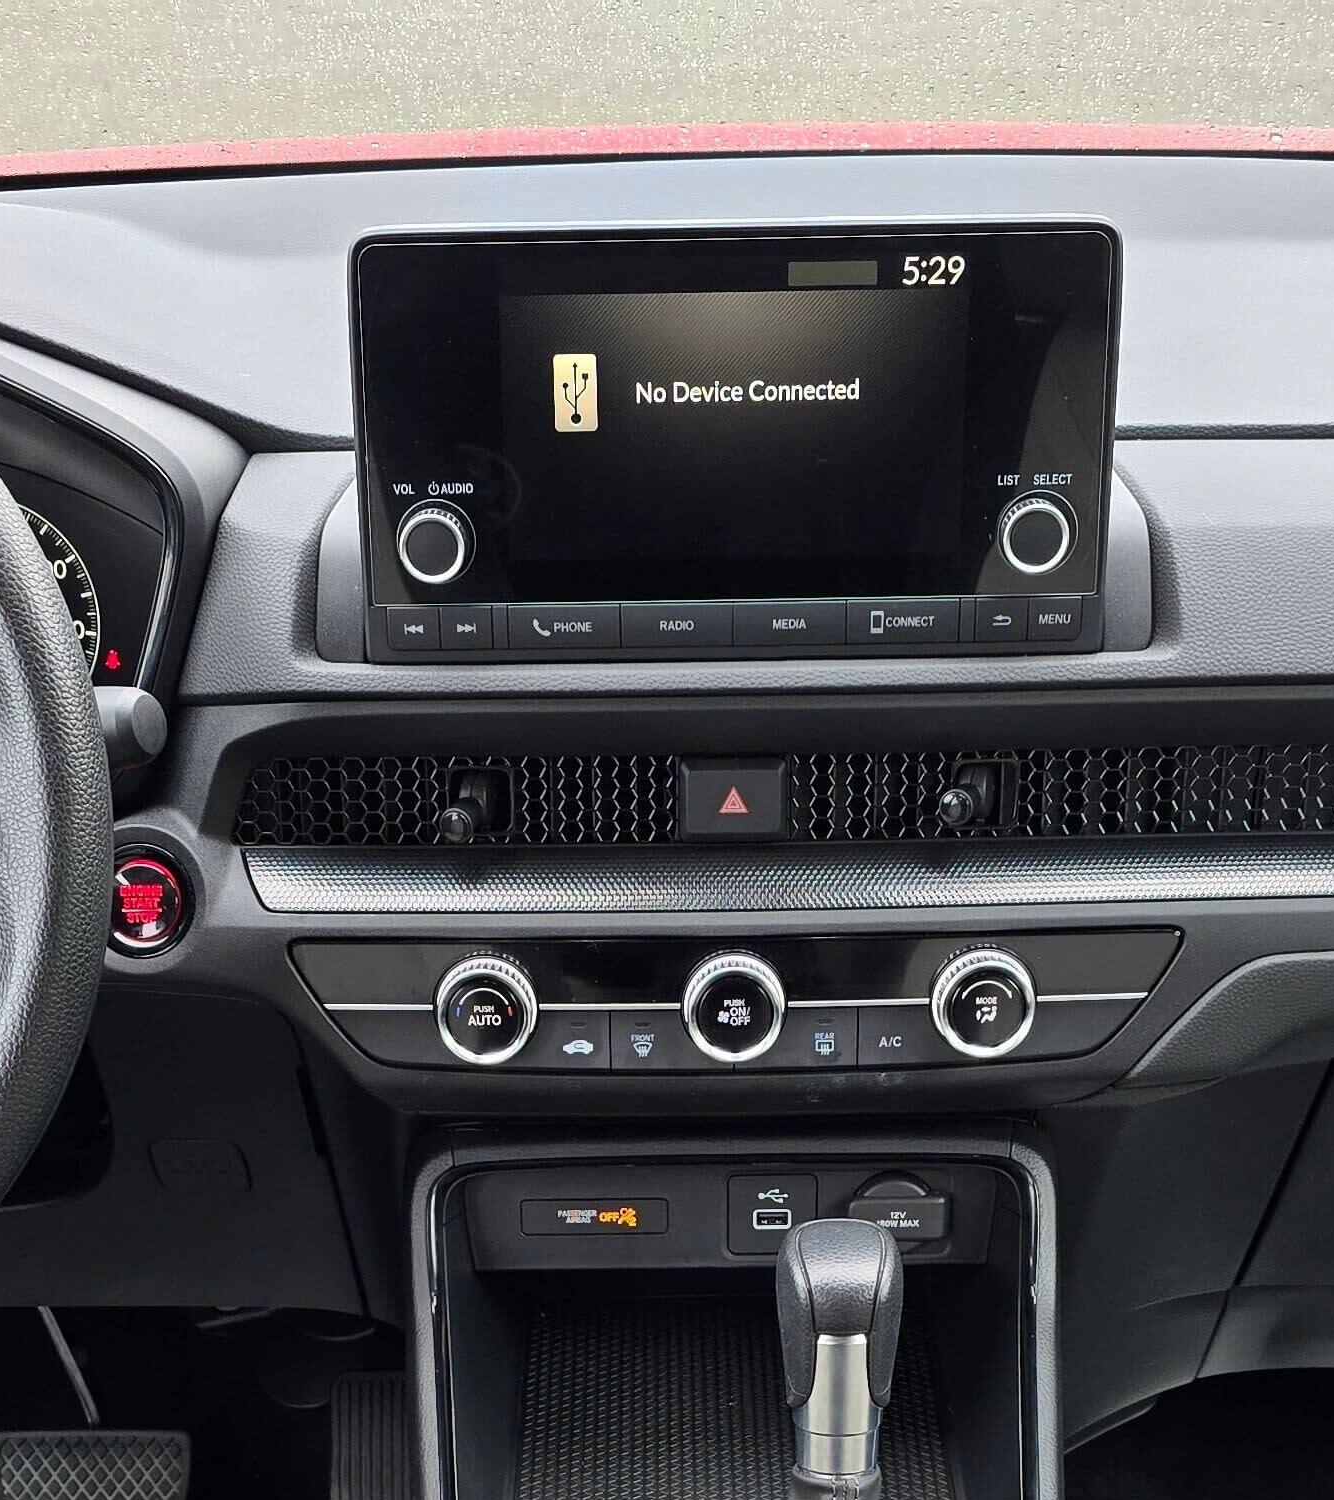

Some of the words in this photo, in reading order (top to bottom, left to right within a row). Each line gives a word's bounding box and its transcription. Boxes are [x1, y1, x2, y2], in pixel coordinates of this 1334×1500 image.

[901, 255, 966, 286] 5:29
[635, 382, 666, 404] No
[673, 380, 743, 404] Device
[749, 378, 860, 403] Connected
[997, 473, 1019, 488] LIST
[1033, 472, 1073, 487] SELECT
[392, 483, 415, 495] VOL
[440, 482, 474, 495] AUDIO
[772, 617, 807, 632] MEDIA
[885, 615, 935, 630] CONNECT
[1038, 613, 1072, 627] MENU
[552, 620, 593, 635] PHONE
[659, 619, 695, 634] RADIO
[123, 897, 160, 909] START
[126, 912, 158, 924] STOP
[724, 998, 746, 1008] PUSH
[975, 996, 998, 1005] MODE
[473, 1005, 495, 1014] PUSH
[468, 1014, 502, 1027] AUTO
[730, 1016, 751, 1027] OFF
[630, 1034, 655, 1042] FRONT
[814, 1032, 835, 1040] REAR
[878, 1035, 902, 1048] A/C
[599, 1211, 620, 1222] OFF
[890, 1210, 907, 1219] 12V
[899, 1219, 920, 1228] MAX
